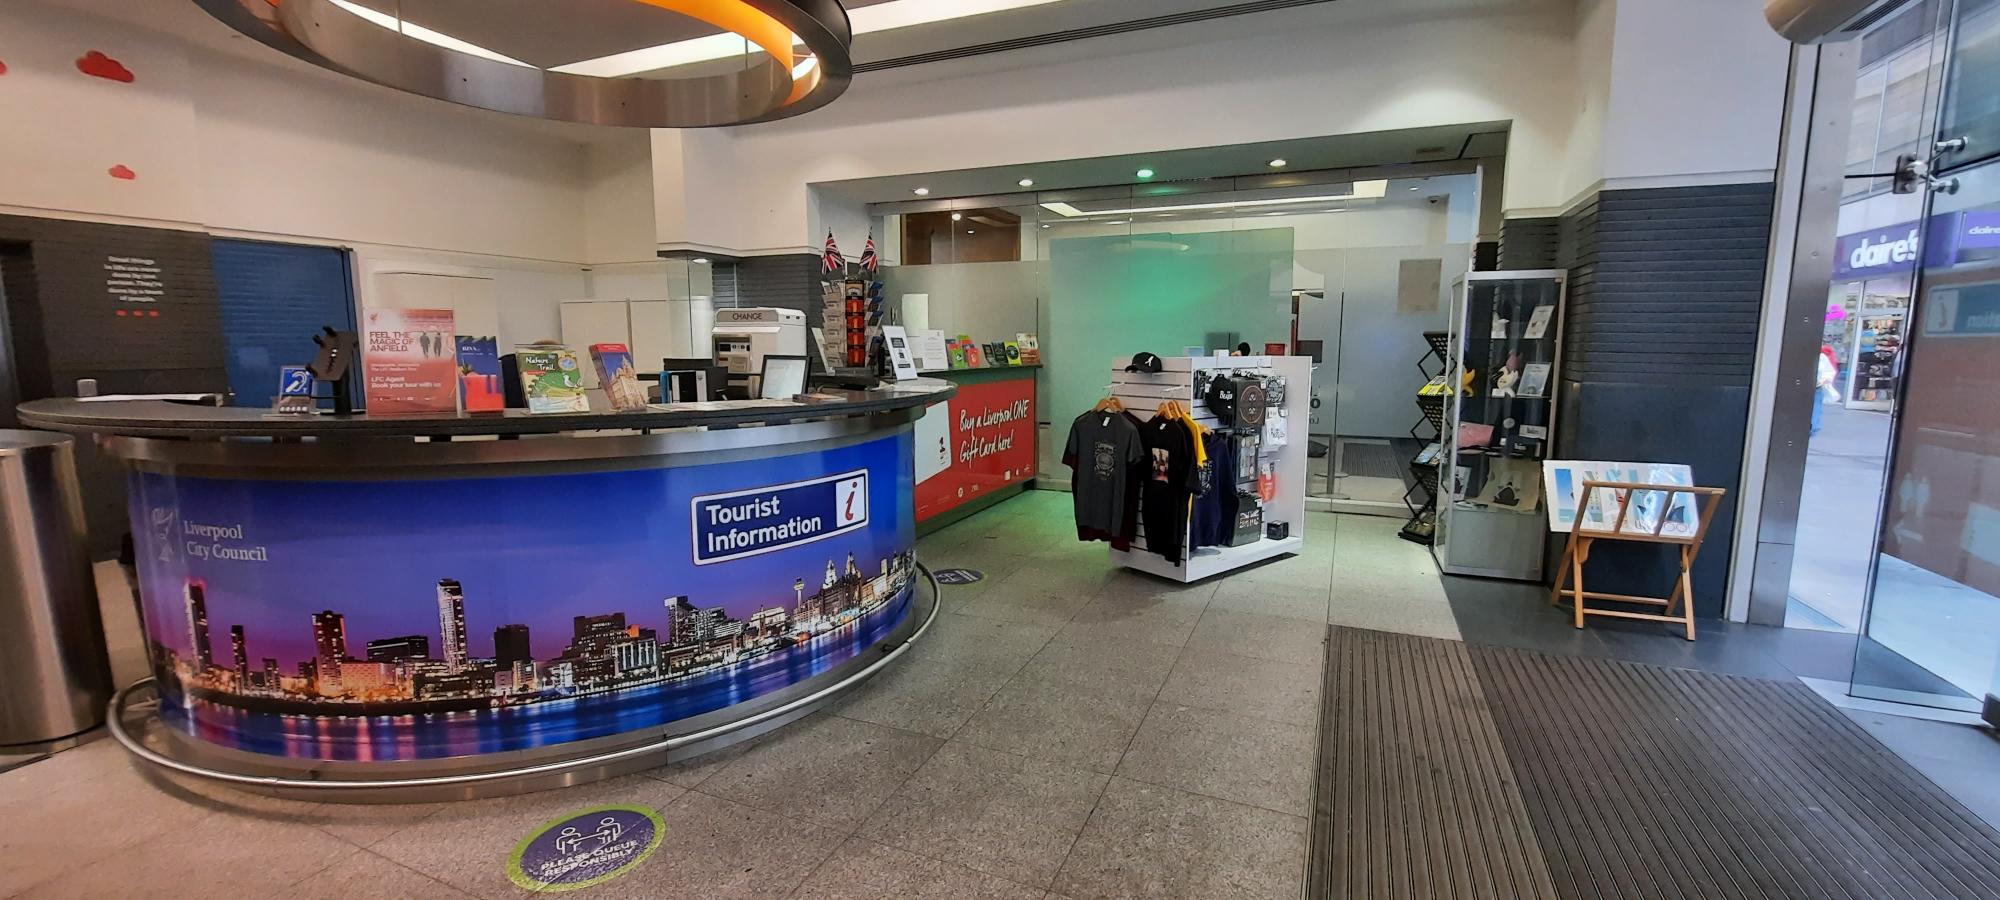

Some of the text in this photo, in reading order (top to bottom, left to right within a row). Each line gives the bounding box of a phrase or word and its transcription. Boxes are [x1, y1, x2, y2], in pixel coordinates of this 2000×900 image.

[732, 312, 763, 321] CHANGE
[369, 331, 411, 339] FEEL THE
[959, 399, 1030, 437] Buy a Liverpool ONE
[959, 436, 980, 469] Gift
[980, 434, 998, 458] Card
[998, 429, 1015, 452] here!
[706, 495, 780, 526] Tourist
[183, 520, 244, 541] Liverpool
[708, 516, 822, 553] Information
[186, 541, 269, 562] City Council
[541, 839, 639, 870] PLEASE QUEUE
[544, 848, 634, 877] RESPONSIBLY
